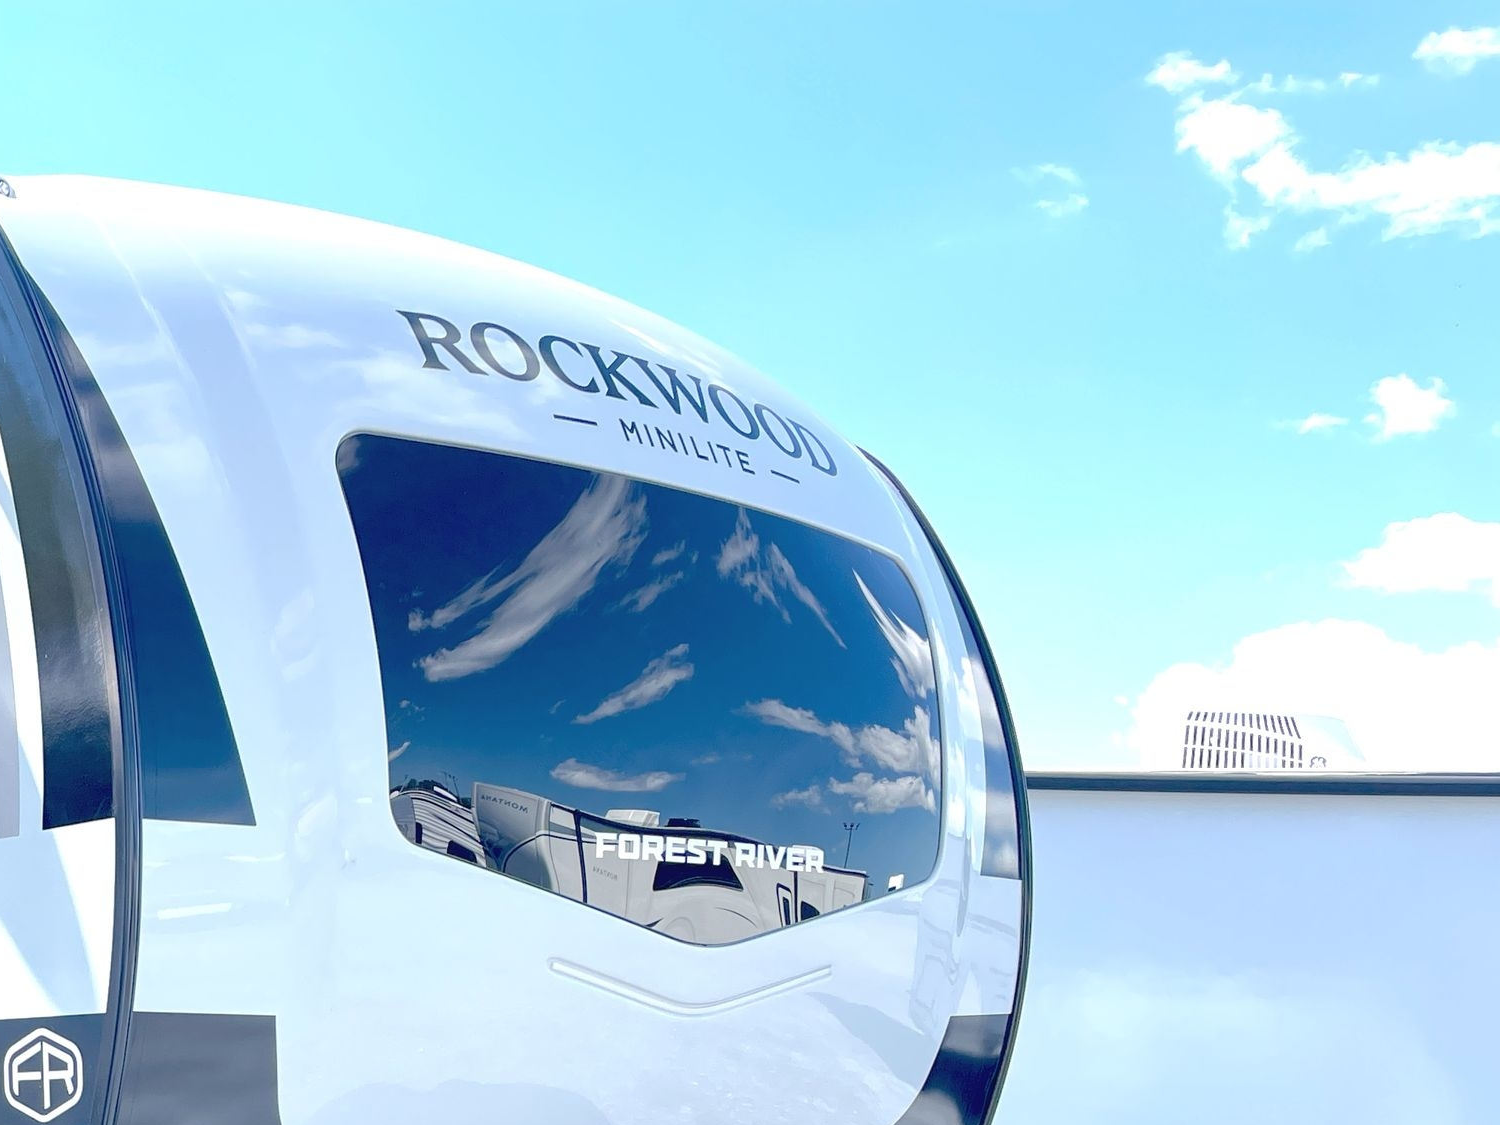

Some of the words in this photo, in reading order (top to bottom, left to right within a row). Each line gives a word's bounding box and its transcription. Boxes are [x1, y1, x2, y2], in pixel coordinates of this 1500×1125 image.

[395, 310, 838, 477] ROCKWOOD
[618, 418, 756, 475] MINILITE
[594, 832, 728, 866] FOREST
[733, 842, 825, 873] RIVER
